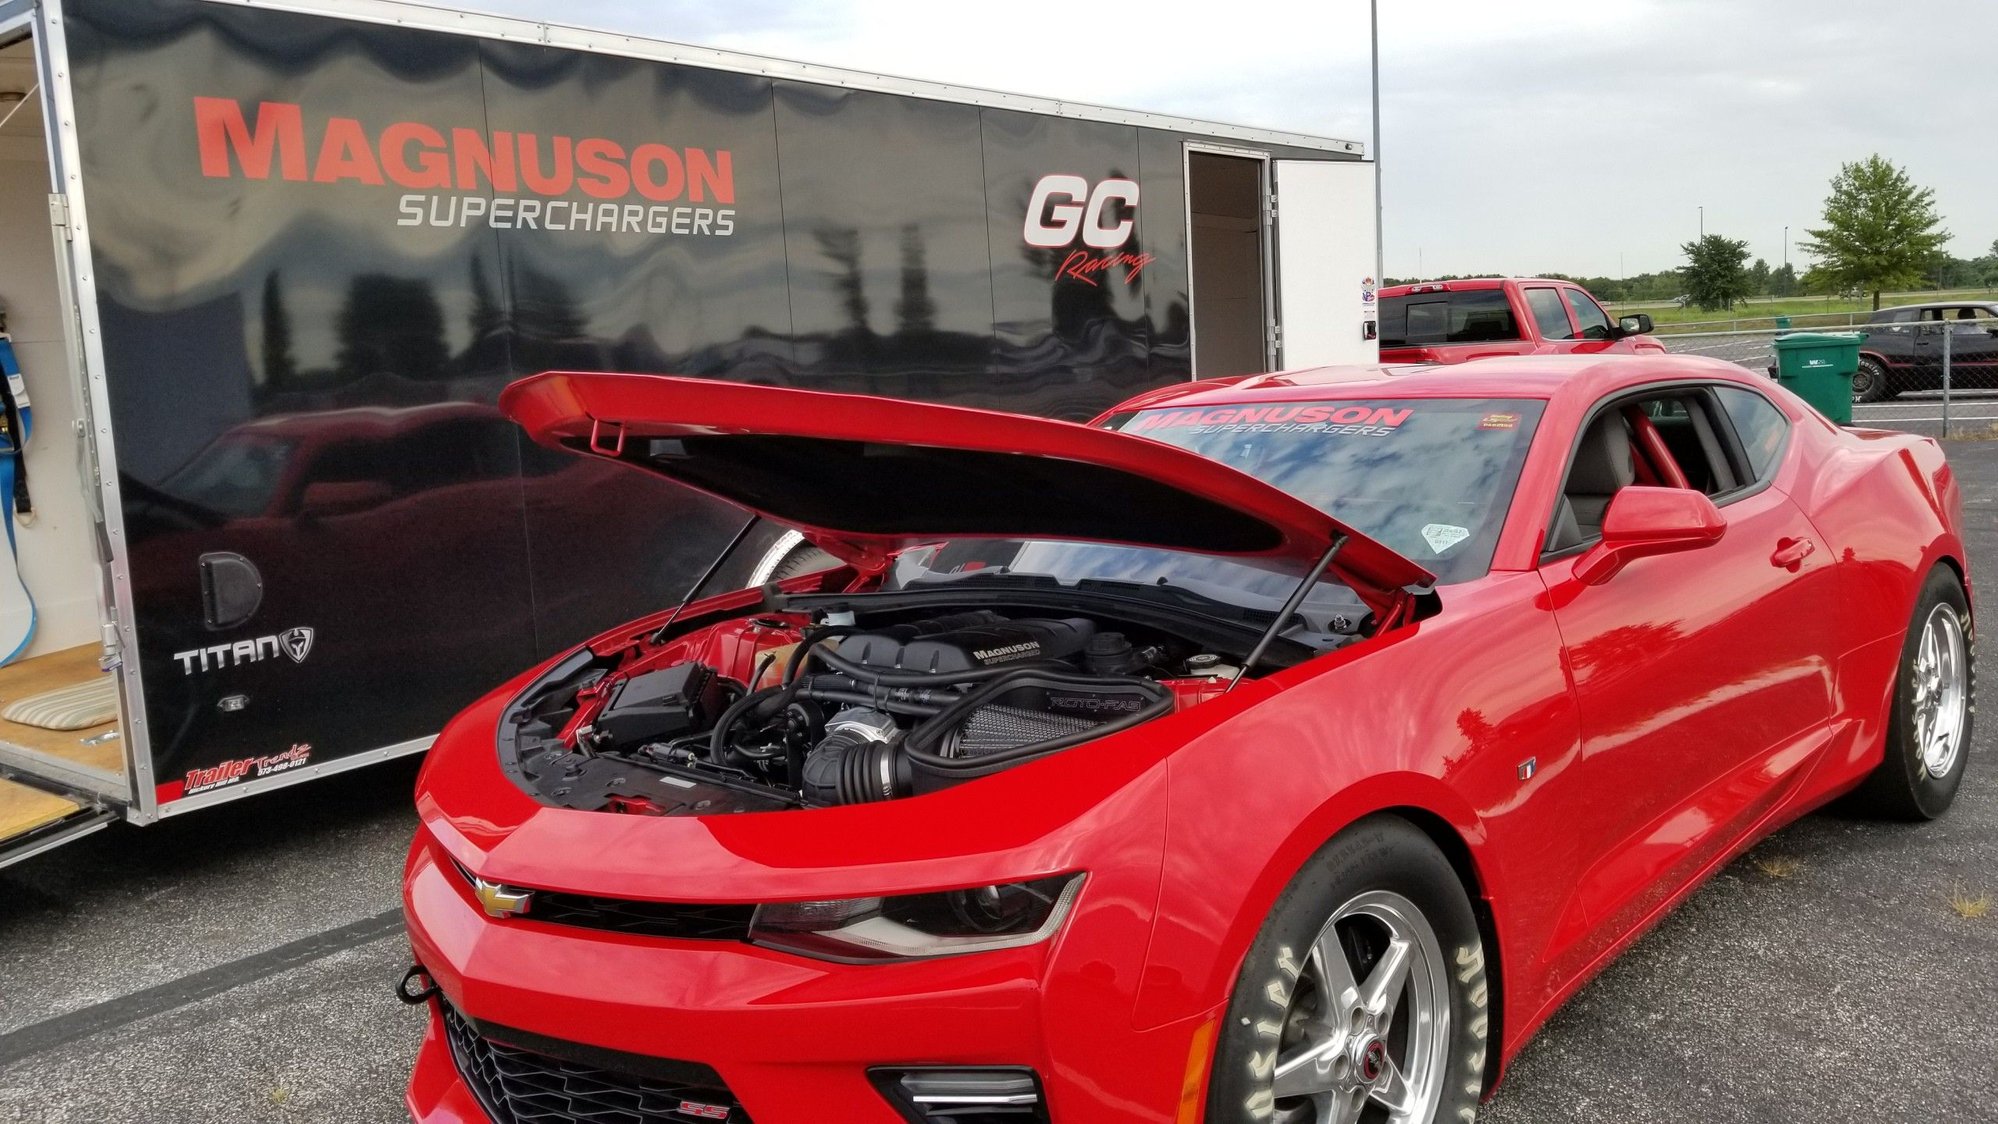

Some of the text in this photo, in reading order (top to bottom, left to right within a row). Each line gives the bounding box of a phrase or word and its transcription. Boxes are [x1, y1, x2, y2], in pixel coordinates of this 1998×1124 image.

[194, 97, 735, 204] MAGNUSON
[396, 194, 735, 236] SUPERCHARGERS
[1023, 174, 1140, 248] GC
[1054, 250, 1156, 286] Racing
[1134, 406, 1414, 431] MAGNUSON
[1190, 423, 1396, 437] SUPERCHARGERS
[173, 635, 279, 675] TITAN
[973, 641, 1040, 660] MAGNUSON
[185, 757, 254, 790] Trailer
[680, 1100, 730, 1119] SS
